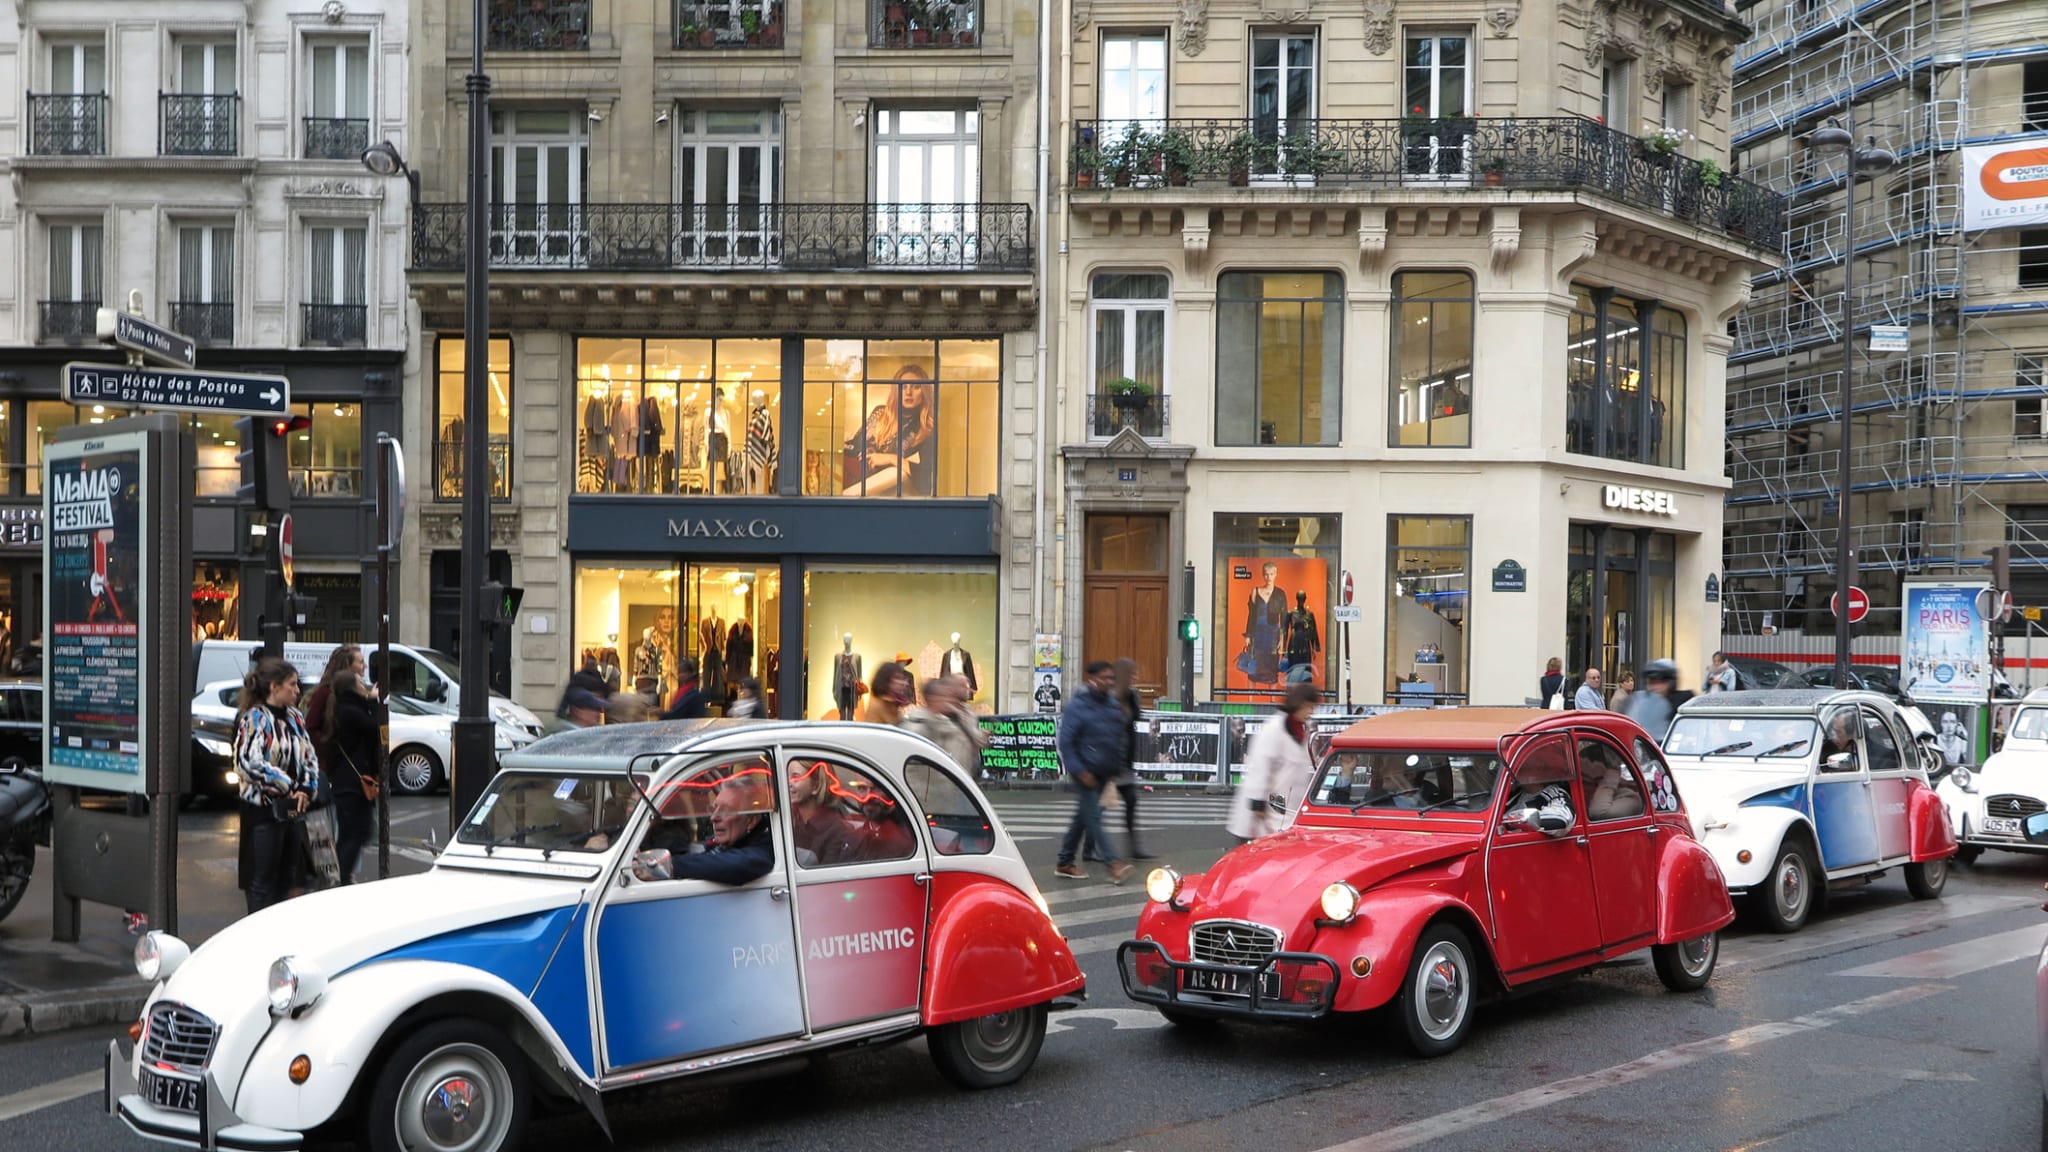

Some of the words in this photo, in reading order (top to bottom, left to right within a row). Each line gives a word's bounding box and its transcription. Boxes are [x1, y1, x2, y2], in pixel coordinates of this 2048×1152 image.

[121, 373, 162, 389] Hôtel
[167, 376, 192, 391] des
[198, 378, 245, 394] Postes
[142, 390, 164, 403] Rue
[169, 391, 183, 403] du
[187, 393, 225, 406] Louvre
[1604, 485, 1679, 515] DIESEL
[667, 518, 784, 538] MAX&Co.
[1920, 609, 1970, 625] PARIS
[1018, 721, 1056, 735] GUIZMO
[732, 943, 790, 969] PARIS
[808, 927, 915, 960] AUTHENTIC
